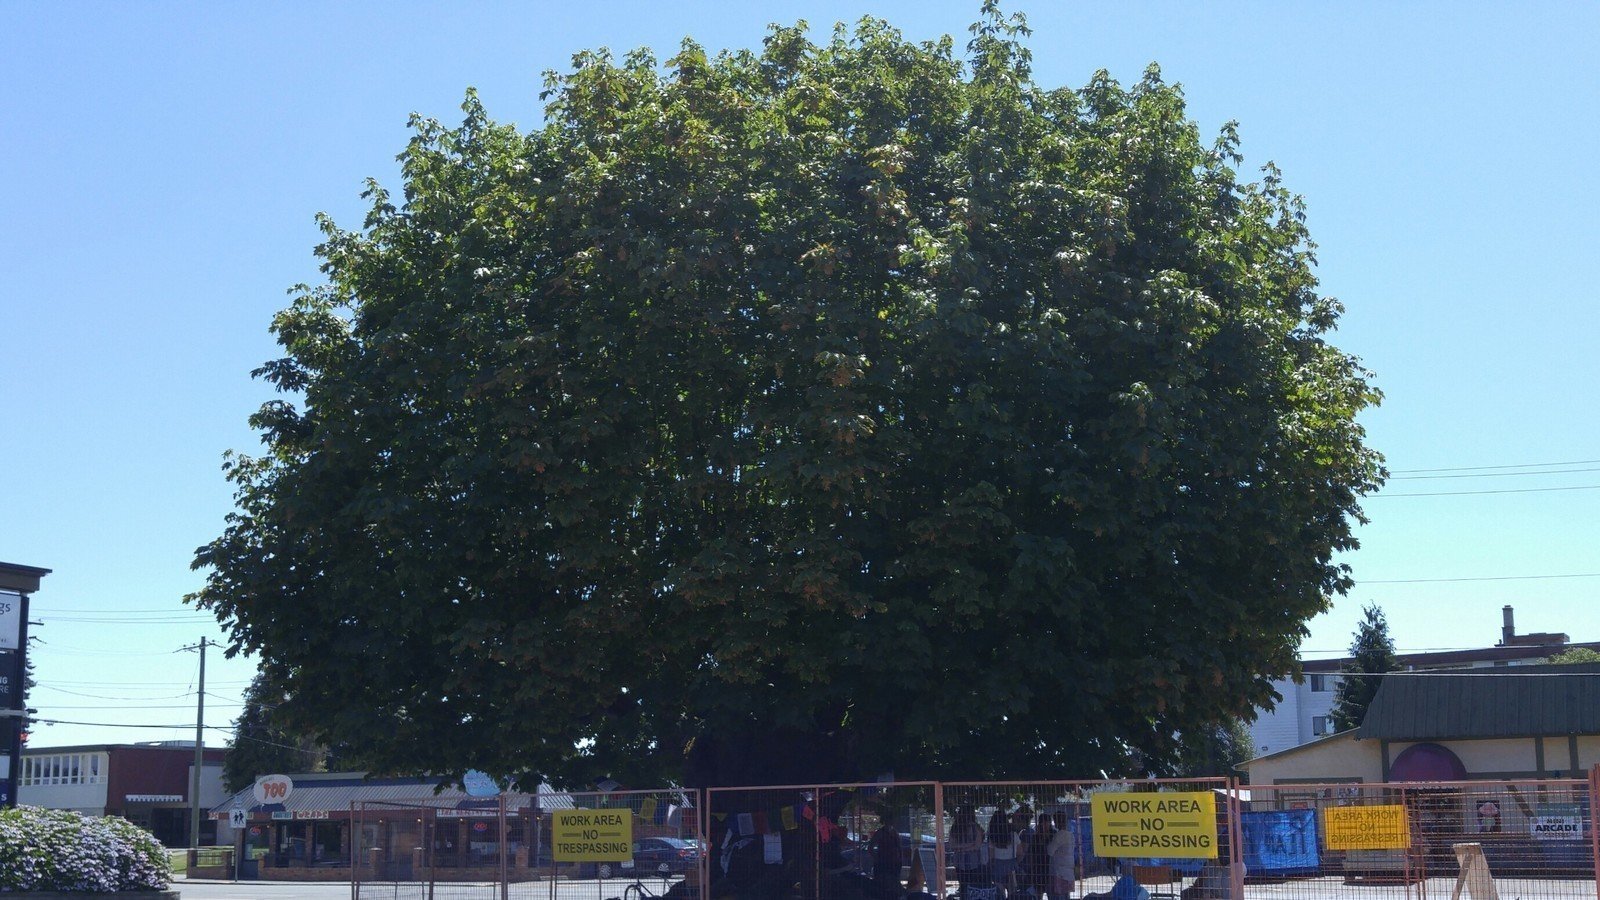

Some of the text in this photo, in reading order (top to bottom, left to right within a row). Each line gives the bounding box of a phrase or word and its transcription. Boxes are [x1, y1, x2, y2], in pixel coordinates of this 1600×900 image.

[263, 782, 287, 799] TOO
[1104, 800, 1201, 813] WORK AREA
[560, 815, 623, 826] WORK AREA
[1140, 818, 1164, 831] NO
[1535, 824, 1578, 832] ARCADE
[583, 829, 598, 840] NO
[1100, 834, 1210, 848] TRESPASSING
[557, 842, 628, 853] TRESPASSING
